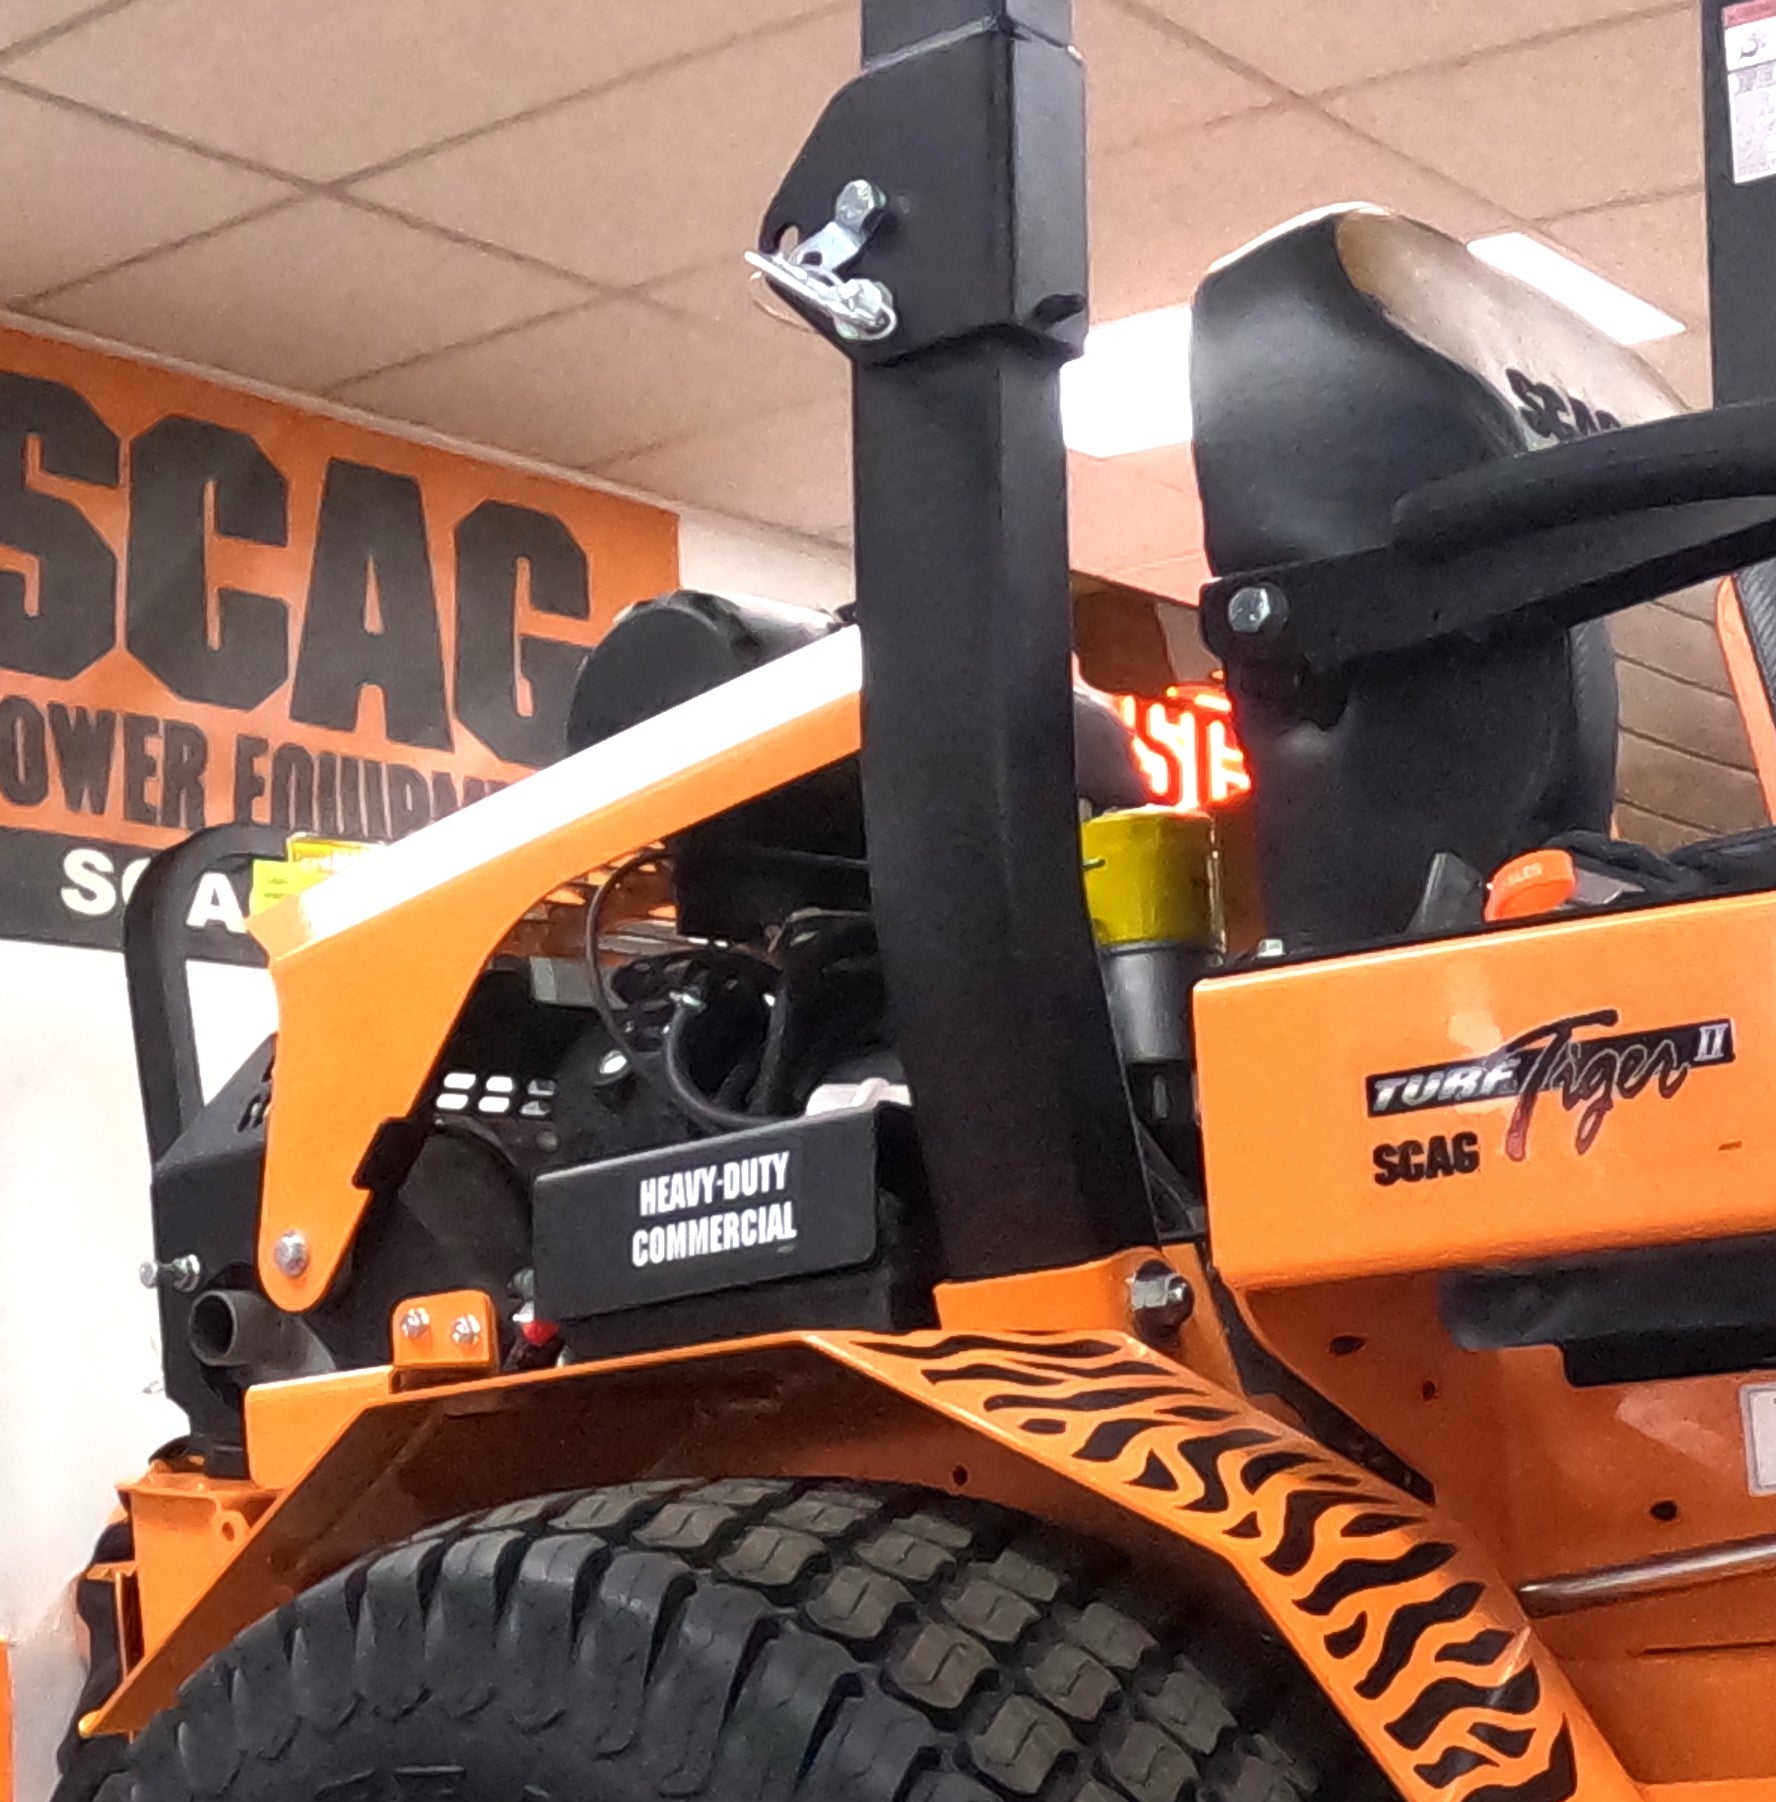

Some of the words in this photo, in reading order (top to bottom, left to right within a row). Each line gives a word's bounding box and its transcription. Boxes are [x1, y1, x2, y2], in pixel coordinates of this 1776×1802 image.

[0, 369, 592, 770] SCAG
[1372, 1056, 1521, 1111] TURF
[1492, 1009, 1692, 1162] Tiger
[640, 1151, 789, 1217] HEAVY-DUTY
[1372, 1131, 1481, 1187] SCAG
[631, 1201, 797, 1269] COMMERCIAL
